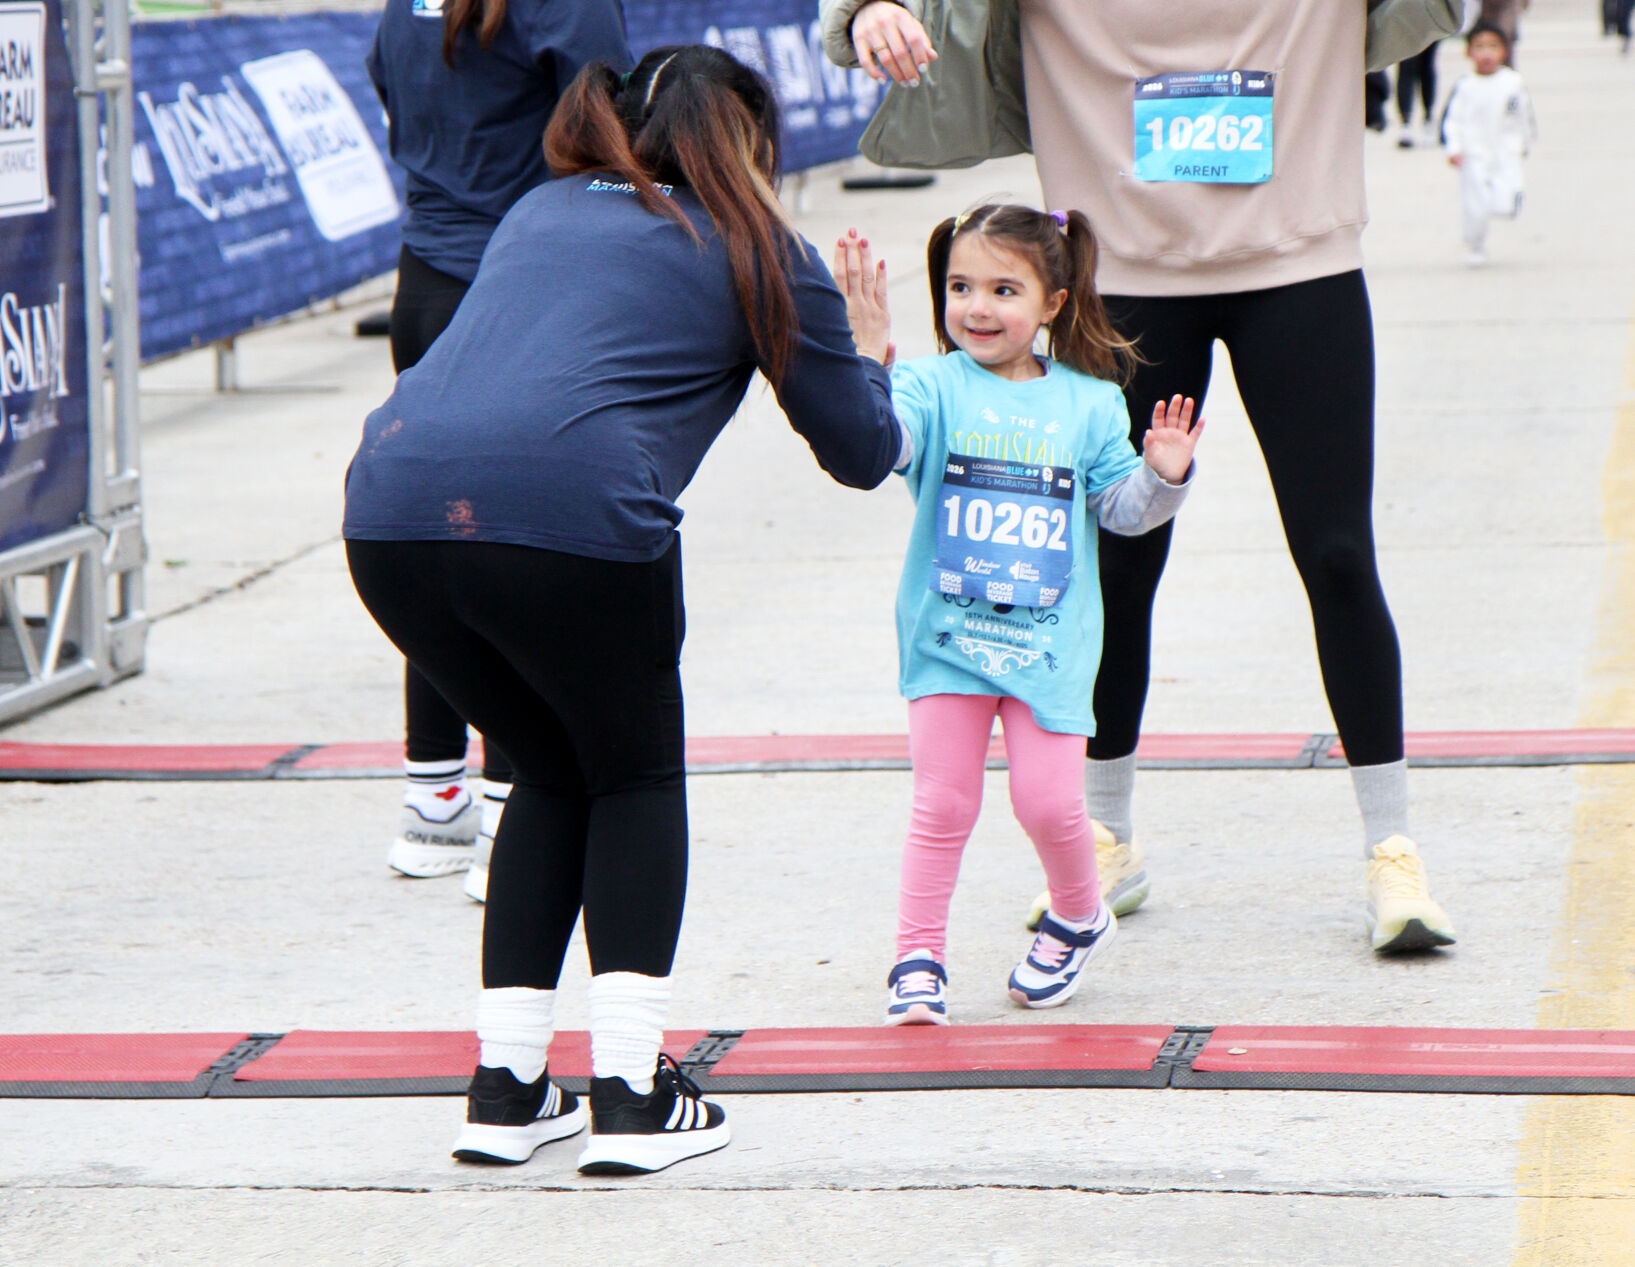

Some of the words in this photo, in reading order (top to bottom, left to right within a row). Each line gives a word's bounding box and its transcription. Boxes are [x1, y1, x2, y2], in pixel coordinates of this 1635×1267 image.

[0, 40, 33, 80] ARM
[0, 88, 35, 129] EAU
[1146, 115, 1263, 151] 10262
[1174, 165, 1229, 177] PARENT
[1009, 416, 1036, 428] THE
[993, 477, 1038, 490] MARATHON
[944, 495, 1067, 551] 10262
[940, 572, 962, 584] FOOD
[987, 581, 1014, 592] FOOD
[987, 593, 1012, 604] TICKET
[985, 614, 1034, 630] ANNIVERSARY
[964, 620, 1034, 642] MARATHON
[405, 830, 427, 844] ON
